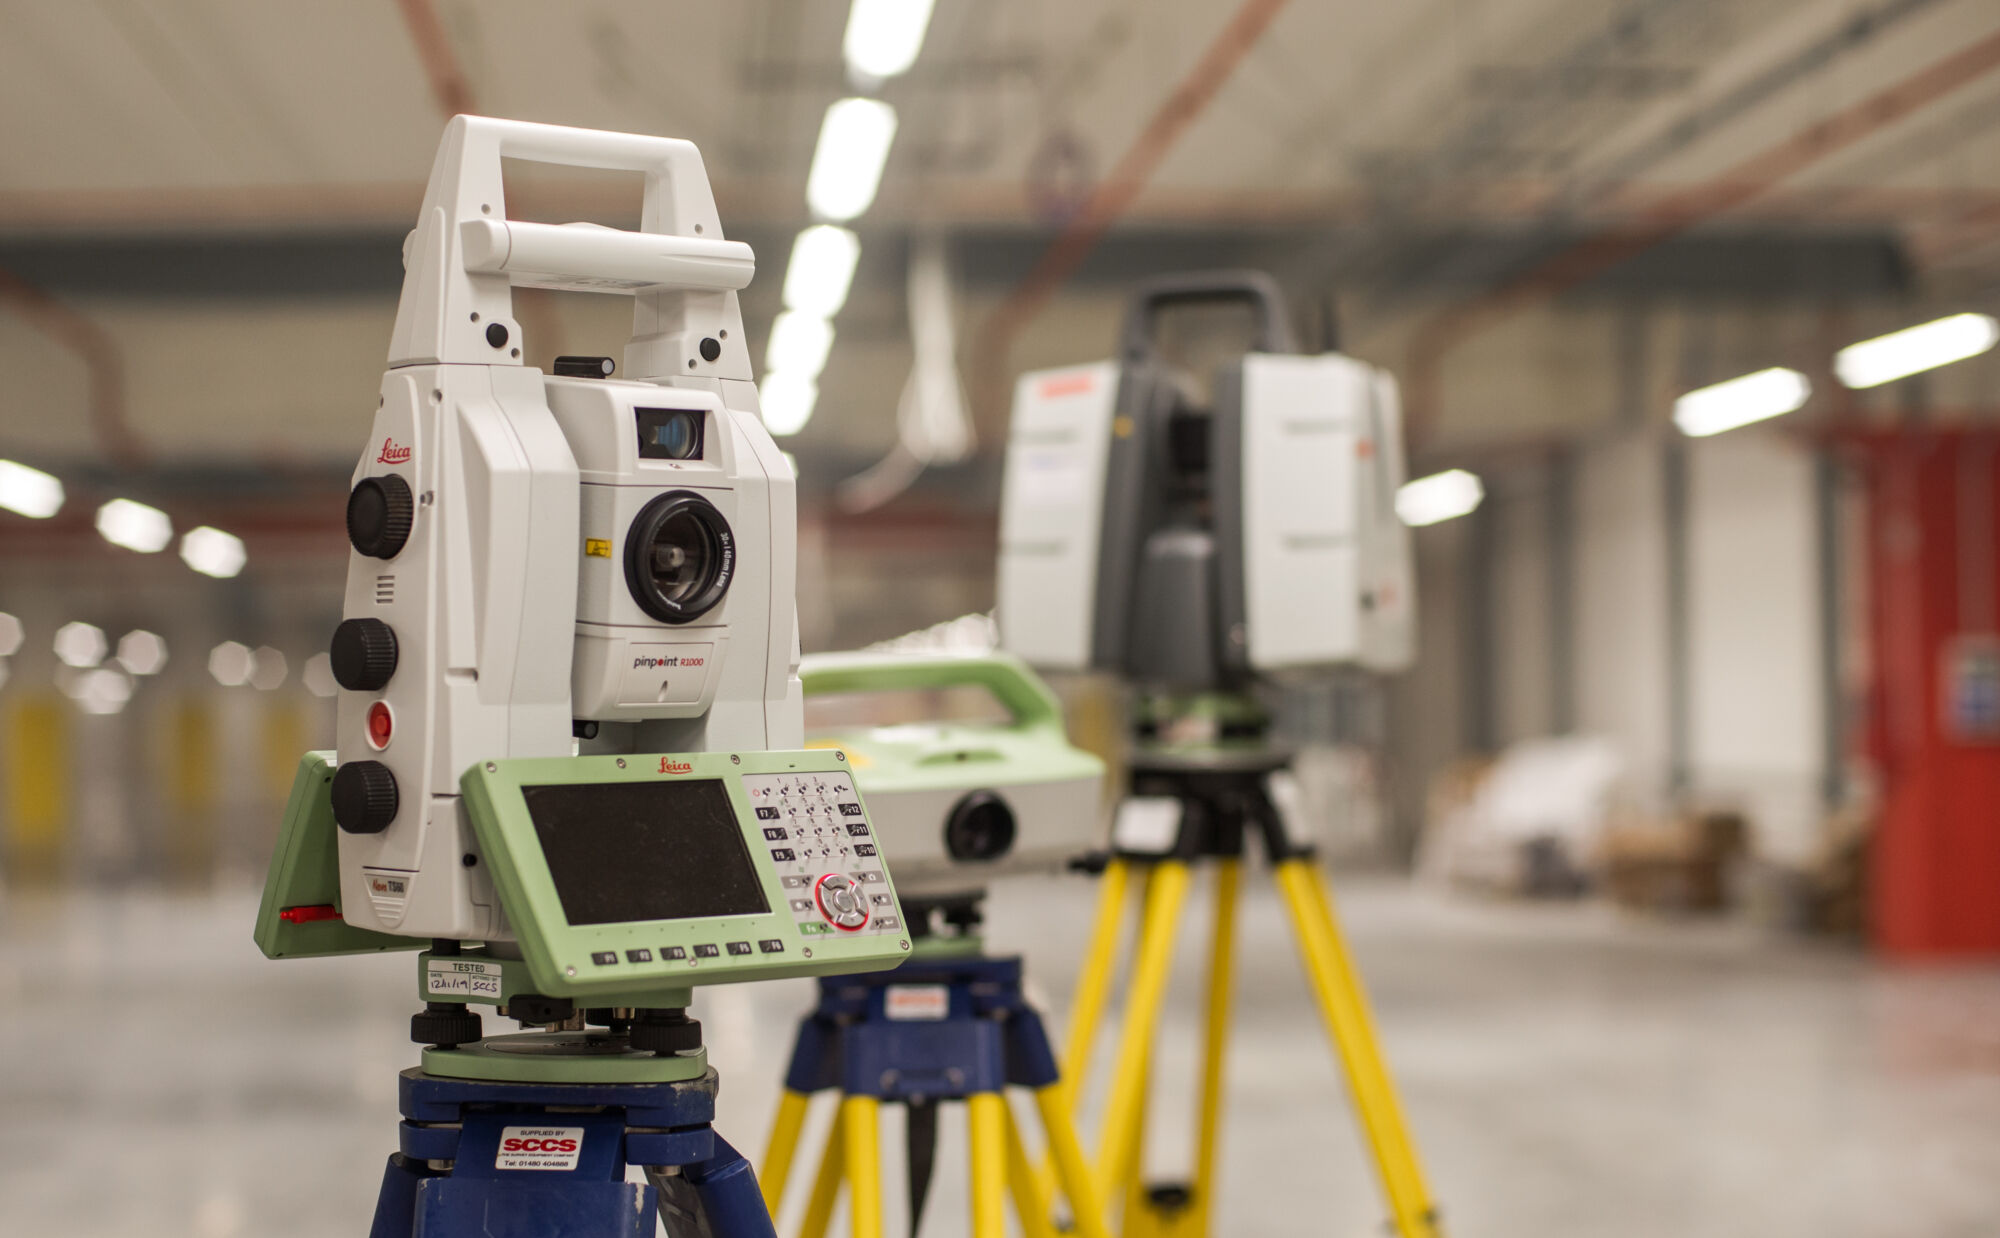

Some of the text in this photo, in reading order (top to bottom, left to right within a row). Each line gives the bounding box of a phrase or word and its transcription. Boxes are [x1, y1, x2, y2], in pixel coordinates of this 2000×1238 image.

[377, 437, 411, 464] Leica
[633, 655, 704, 669] pinpoint R1000
[657, 756, 692, 775] Leica
[452, 963, 485, 973] TESTED
[472, 981, 498, 992] SCCS
[503, 1138, 577, 1152] SCCS
